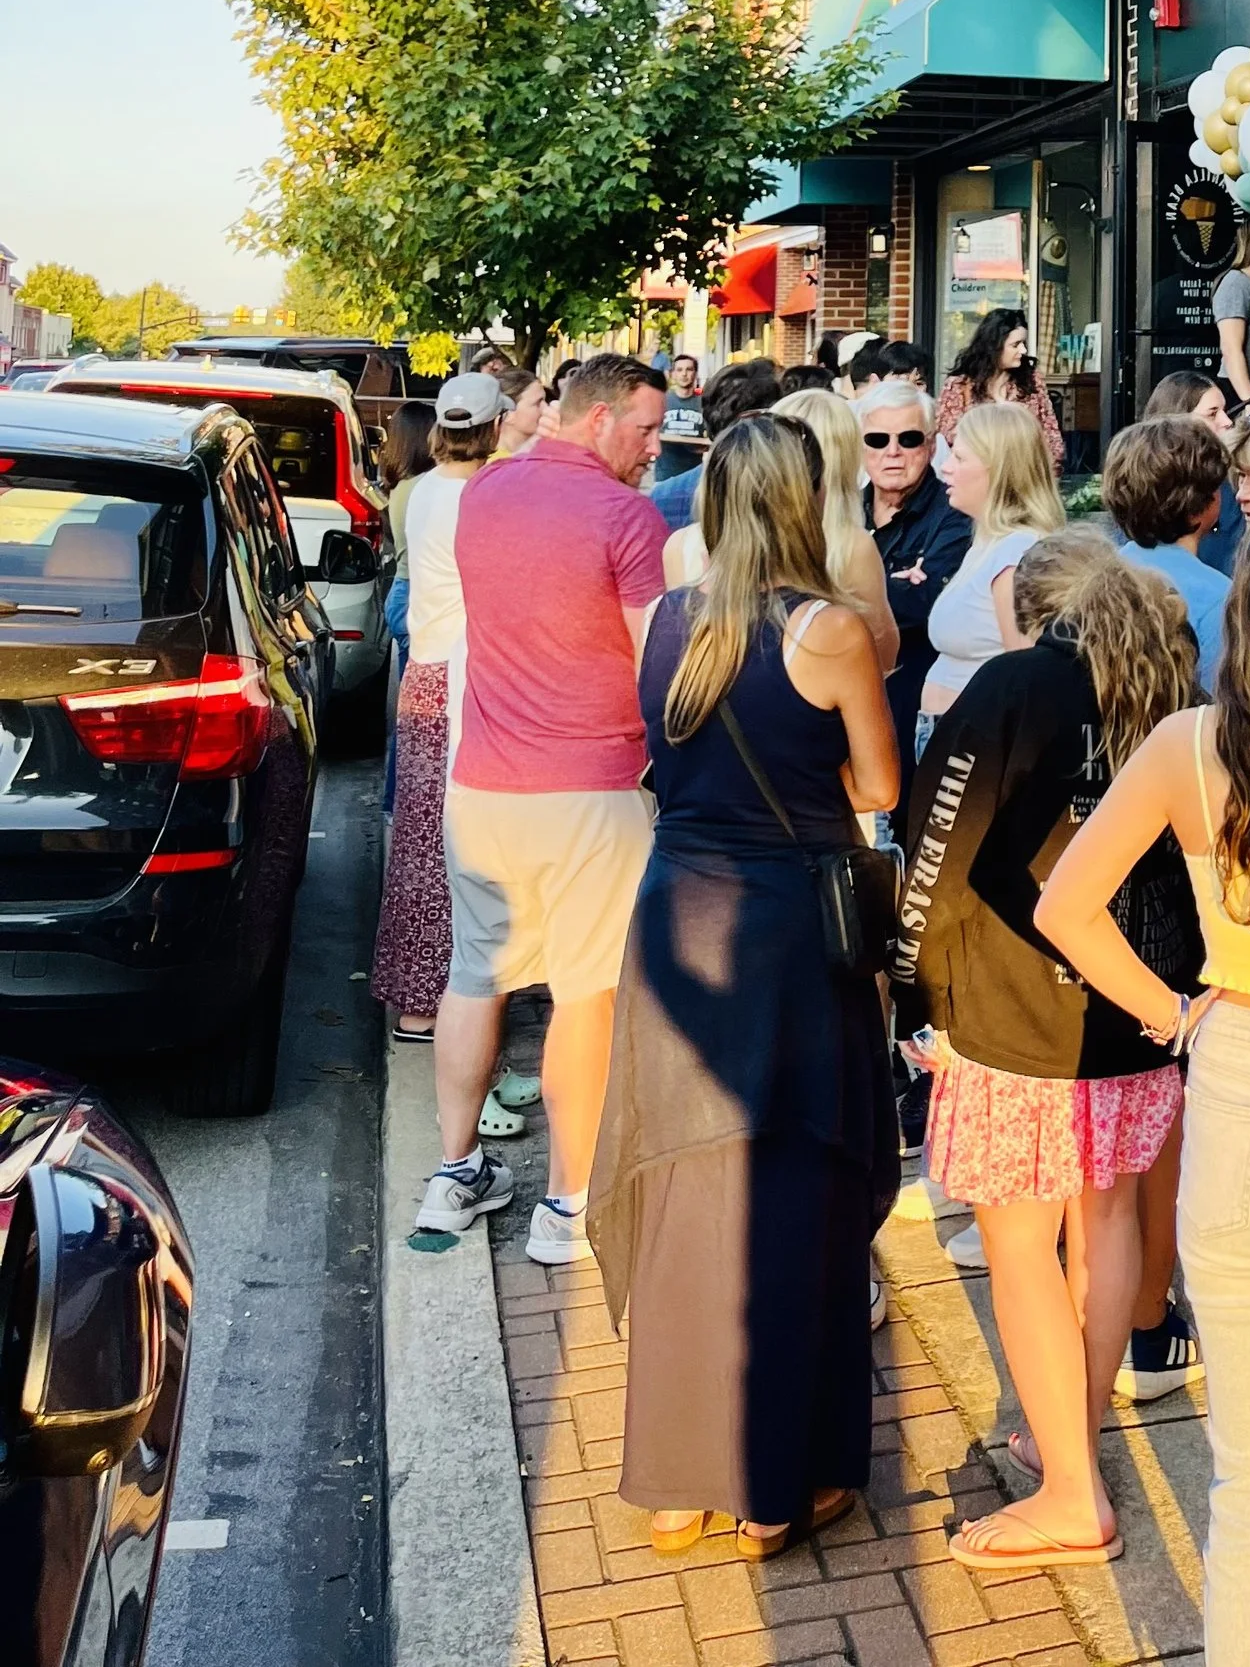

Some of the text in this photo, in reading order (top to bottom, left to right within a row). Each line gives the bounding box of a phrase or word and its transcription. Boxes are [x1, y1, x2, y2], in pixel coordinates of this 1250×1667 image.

[951, 282, 987, 293] Children
[67, 658, 157, 675] X3
[928, 751, 976, 832] THE
[901, 833, 948, 933] ERAS
